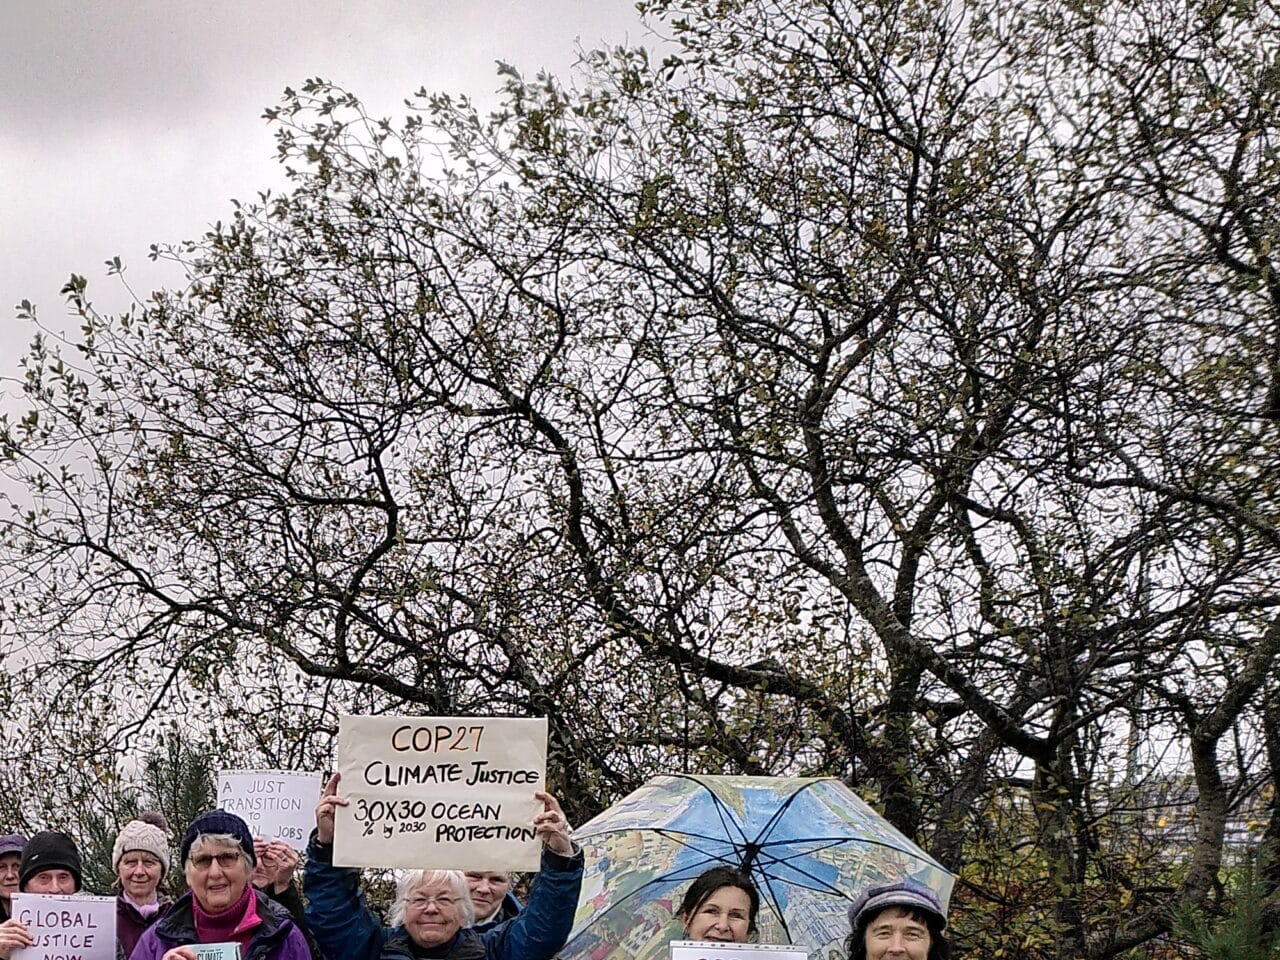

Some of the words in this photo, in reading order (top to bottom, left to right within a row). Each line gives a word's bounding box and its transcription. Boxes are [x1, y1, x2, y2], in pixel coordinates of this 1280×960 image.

[392, 725, 484, 753] COP27
[222, 781, 233, 794] A
[247, 780, 286, 794] JUST
[220, 797, 302, 811] TRANSITION
[354, 799, 427, 822] 30X30
[431, 802, 502, 821] OCEAN
[249, 812, 261, 821] TO
[273, 825, 304, 841] JOBS
[399, 821, 427, 834] 2030
[435, 823, 538, 843] PROTECTION
[19, 909, 98, 929] GLOBAL
